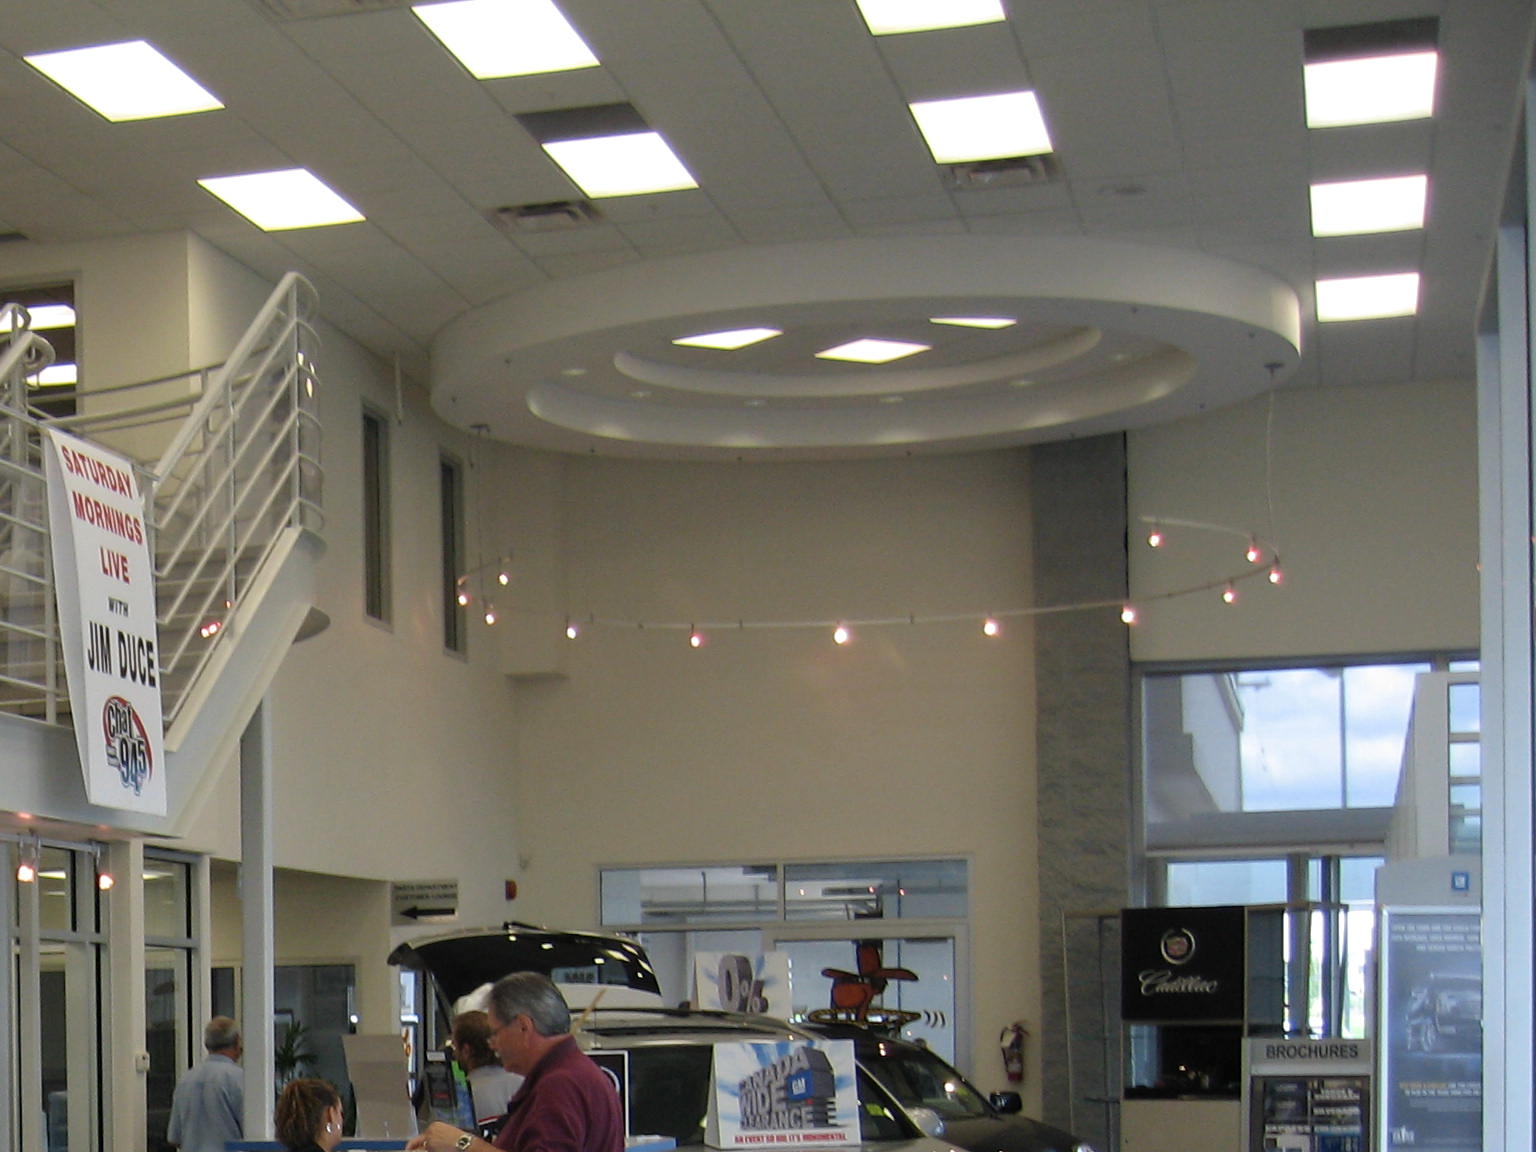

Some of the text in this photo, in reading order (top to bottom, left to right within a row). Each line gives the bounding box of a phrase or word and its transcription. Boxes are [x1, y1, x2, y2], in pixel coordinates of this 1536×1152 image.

[61, 445, 133, 500] SATURDAY
[72, 491, 143, 545] MORNINGS
[100, 546, 130, 584] LIVE
[107, 597, 129, 617] WITH
[87, 621, 156, 688] JIM DUCE
[1138, 969, 1218, 996] Cadillac
[739, 1046, 811, 1091] CANADA
[1266, 1043, 1359, 1060] BROCHURES
[738, 1082, 788, 1117] WIDE
[791, 1077, 806, 1096] GM
[739, 1105, 815, 1131] CLEARANCE
